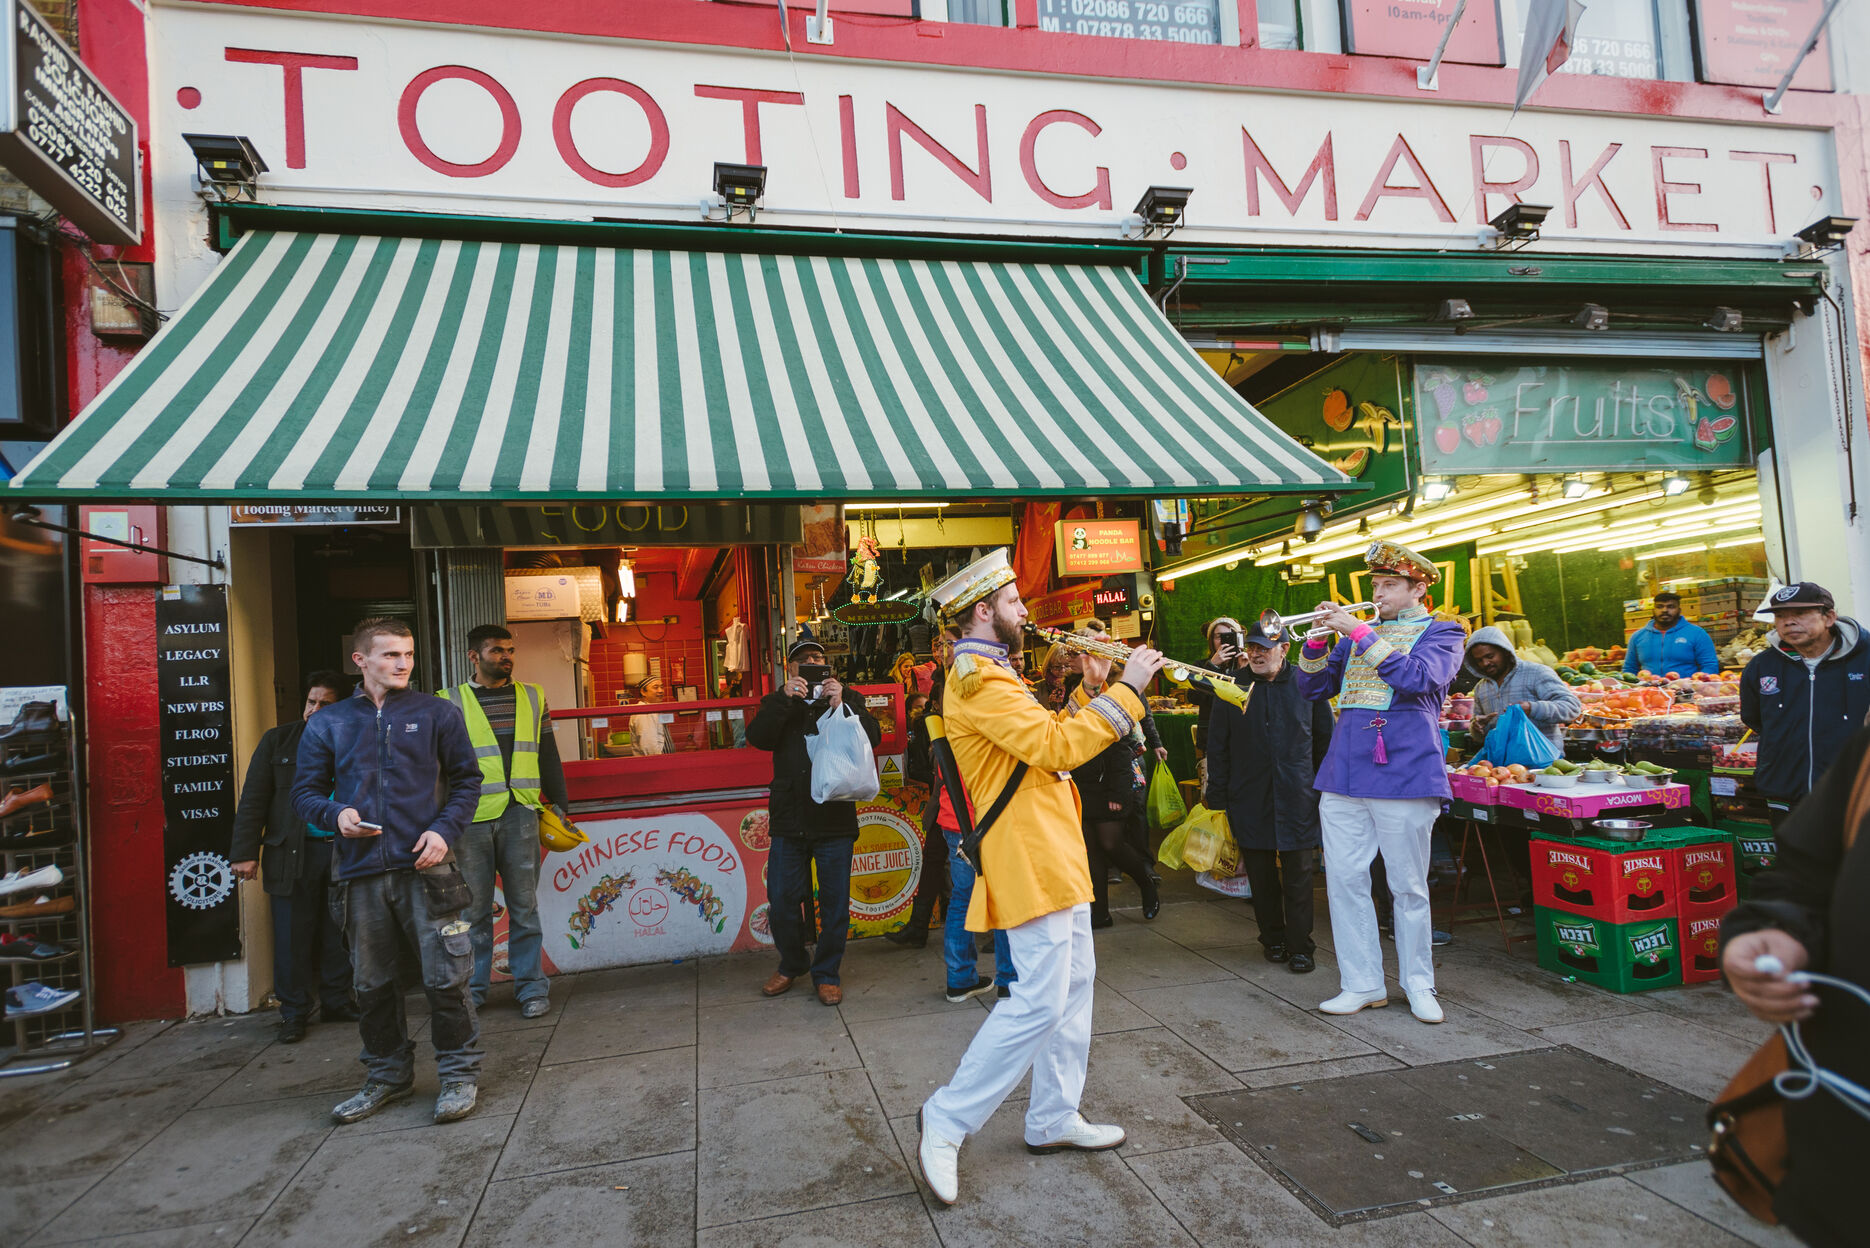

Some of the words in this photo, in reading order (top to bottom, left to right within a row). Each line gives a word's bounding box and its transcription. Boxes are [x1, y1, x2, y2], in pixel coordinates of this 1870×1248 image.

[1072, 0, 1130, 19] 02086
[1135, 4, 1170, 23] 720
[1174, 8, 1208, 26] 666
[1076, 21, 1133, 38] 07878
[1139, 26, 1163, 41] 33
[1168, 28, 1212, 45] 5000
[1592, 40, 1620, 57] 720
[1624, 43, 1651, 60] 666
[19, 10, 69, 73] RASHID
[87, 83, 127, 135] RASHID
[43, 55, 112, 137] SOLICITORS
[35, 66, 119, 160] IMMIGRATION
[224, 46, 1112, 211] TOOTING
[1241, 125, 1797, 233] MARKET
[28, 107, 74, 157] 02086
[79, 154, 102, 183] 720
[106, 182, 127, 207] 666
[28, 124, 65, 162] 0777
[69, 164, 102, 199] 4222
[105, 195, 127, 223] 062
[1513, 380, 1676, 437] Fruits
[1096, 591, 1126, 604] HALAL
[165, 623, 221, 635] ASYLUM
[166, 649, 221, 661] LEGACY
[180, 675, 210, 687] I.L.R
[167, 702, 199, 714] NEW
[201, 701, 224, 713] PBS
[175, 727, 219, 741] FLR(O)
[167, 753, 228, 767] STUDENT
[174, 780, 223, 794] FAMILY
[1607, 793, 1642, 806] MOYCA
[181, 807, 219, 820] VISAS
[1743, 842, 1776, 853] LECH
[553, 830, 660, 893] CHINESE
[667, 832, 738, 875] FOOD
[851, 854, 882, 873] ANGE
[883, 850, 911, 869] JUICE
[1549, 851, 1590, 870] TYSKIE
[1624, 856, 1664, 873] TYSKIE
[1685, 850, 1724, 867] TYSKIE
[183, 890, 222, 905] SOLICITORS
[634, 927, 667, 937] HALAL
[1561, 927, 1594, 943] LECH
[1689, 918, 1720, 935] YSKIE
[1635, 931, 1667, 952] LECH
